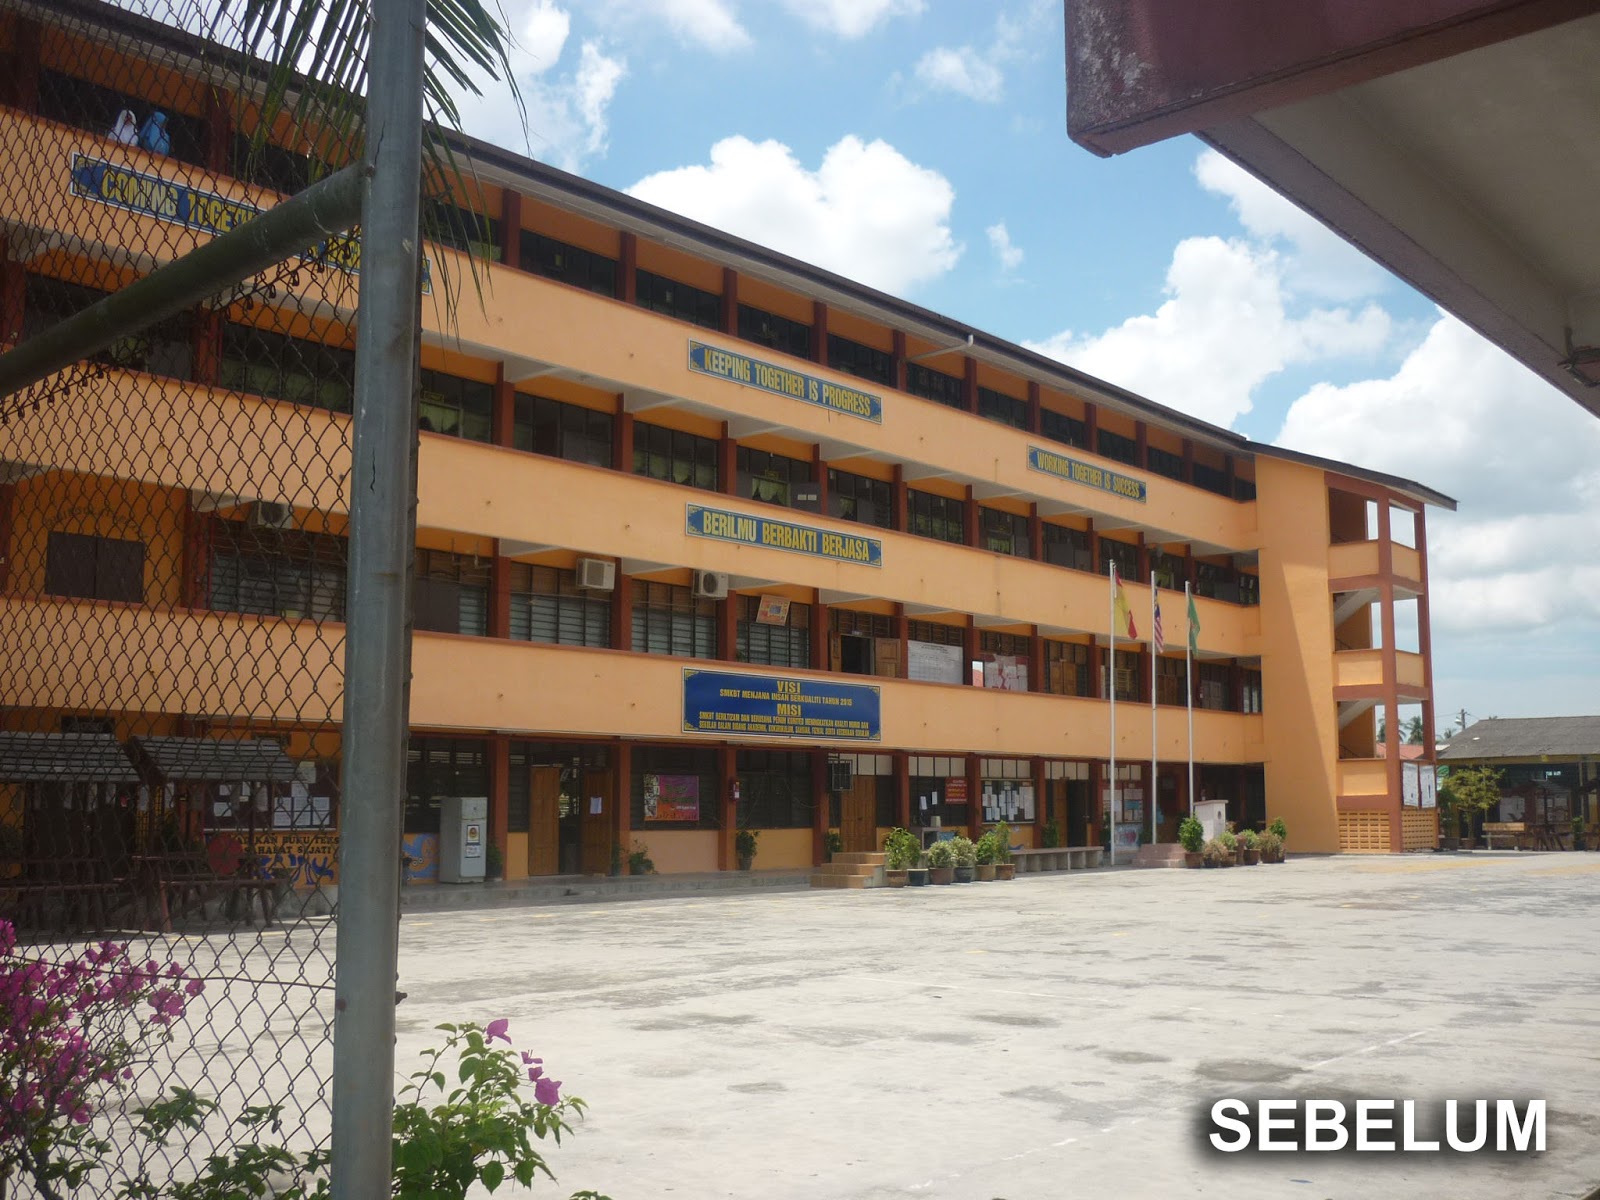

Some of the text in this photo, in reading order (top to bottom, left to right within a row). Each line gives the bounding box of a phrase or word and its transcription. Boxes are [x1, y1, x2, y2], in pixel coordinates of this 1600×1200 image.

[101, 168, 179, 218] COMING
[704, 348, 871, 417] KEEPING TOGETHER IS PROGRESS
[1037, 452, 1140, 498] WORKING TOGETHER IS SUCCESS
[703, 511, 870, 562] BERILMU BERBAKTI BERJASA
[742, 690, 770, 700] MENJANA
[772, 692, 789, 701] INSAN
[790, 694, 821, 704] BERKUALITI
[822, 697, 840, 705] TAHUN
[777, 680, 800, 693] VISI
[777, 703, 801, 716] MISI
